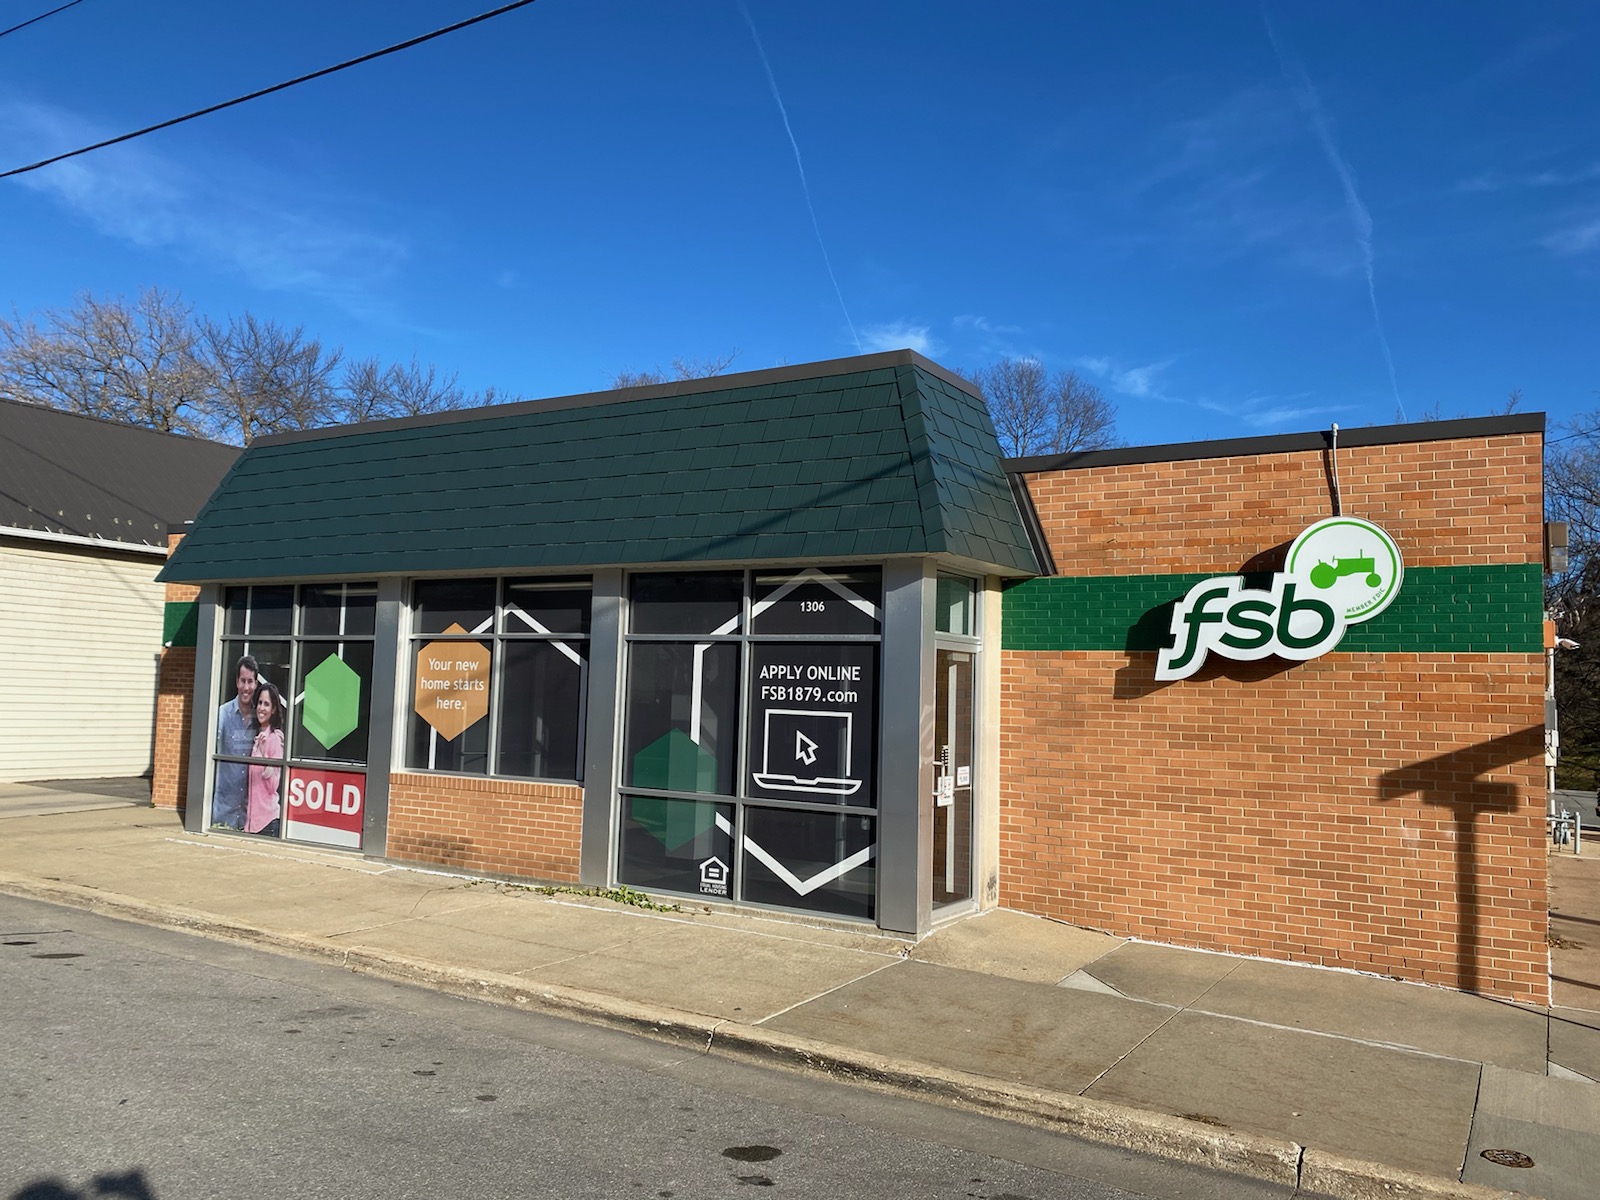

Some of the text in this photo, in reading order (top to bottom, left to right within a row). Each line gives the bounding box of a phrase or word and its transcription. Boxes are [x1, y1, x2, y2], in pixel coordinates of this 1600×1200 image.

[800, 601, 825, 612] 1306
[1346, 588, 1386, 613] MEMBER FDIC
[1168, 583, 1335, 670] fsb
[428, 657, 479, 671] Your new
[759, 664, 861, 681] APPLY ONLINE
[420, 676, 485, 691] home starts
[761, 685, 858, 703] FSB1879.com
[436, 696, 465, 710] here.
[289, 777, 361, 816] SOLD
[699, 887, 728, 896] LENDER
